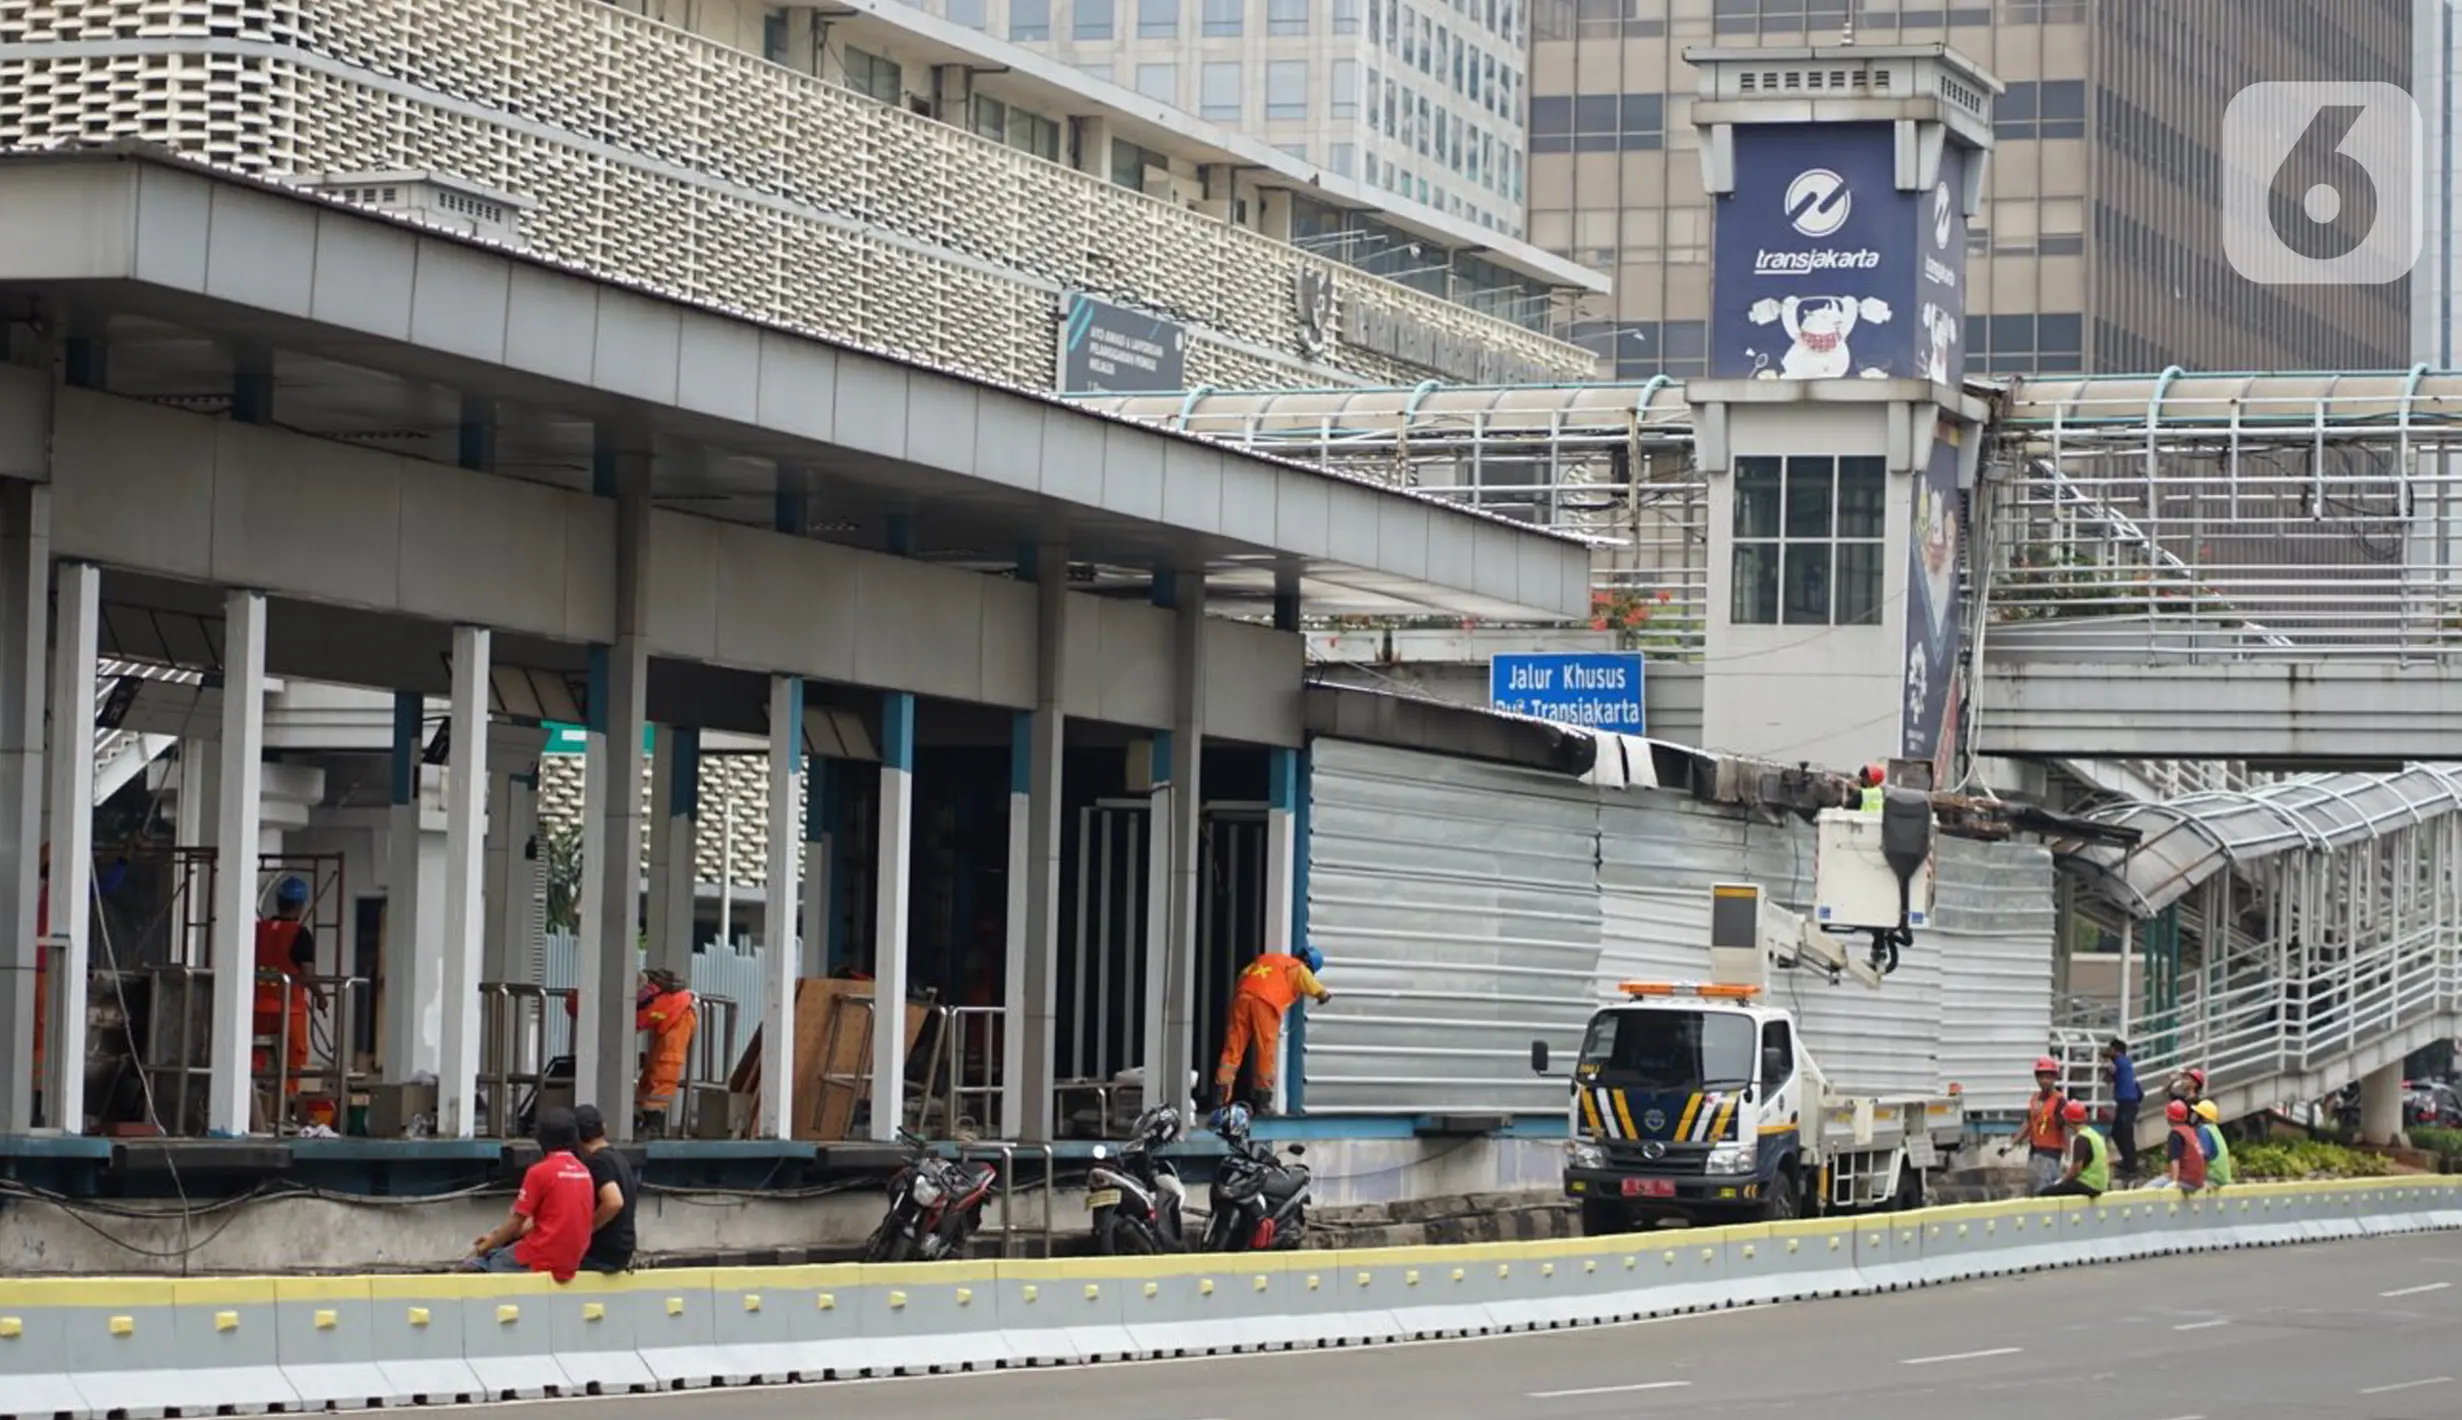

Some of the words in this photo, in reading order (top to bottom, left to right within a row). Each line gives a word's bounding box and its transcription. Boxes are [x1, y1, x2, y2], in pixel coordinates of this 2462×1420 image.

[1754, 248, 1880, 275] transjakarta
[1508, 663, 1553, 691] Jalur
[1563, 663, 1627, 691] Khusus
[1531, 697, 1641, 727] Transjakarta
